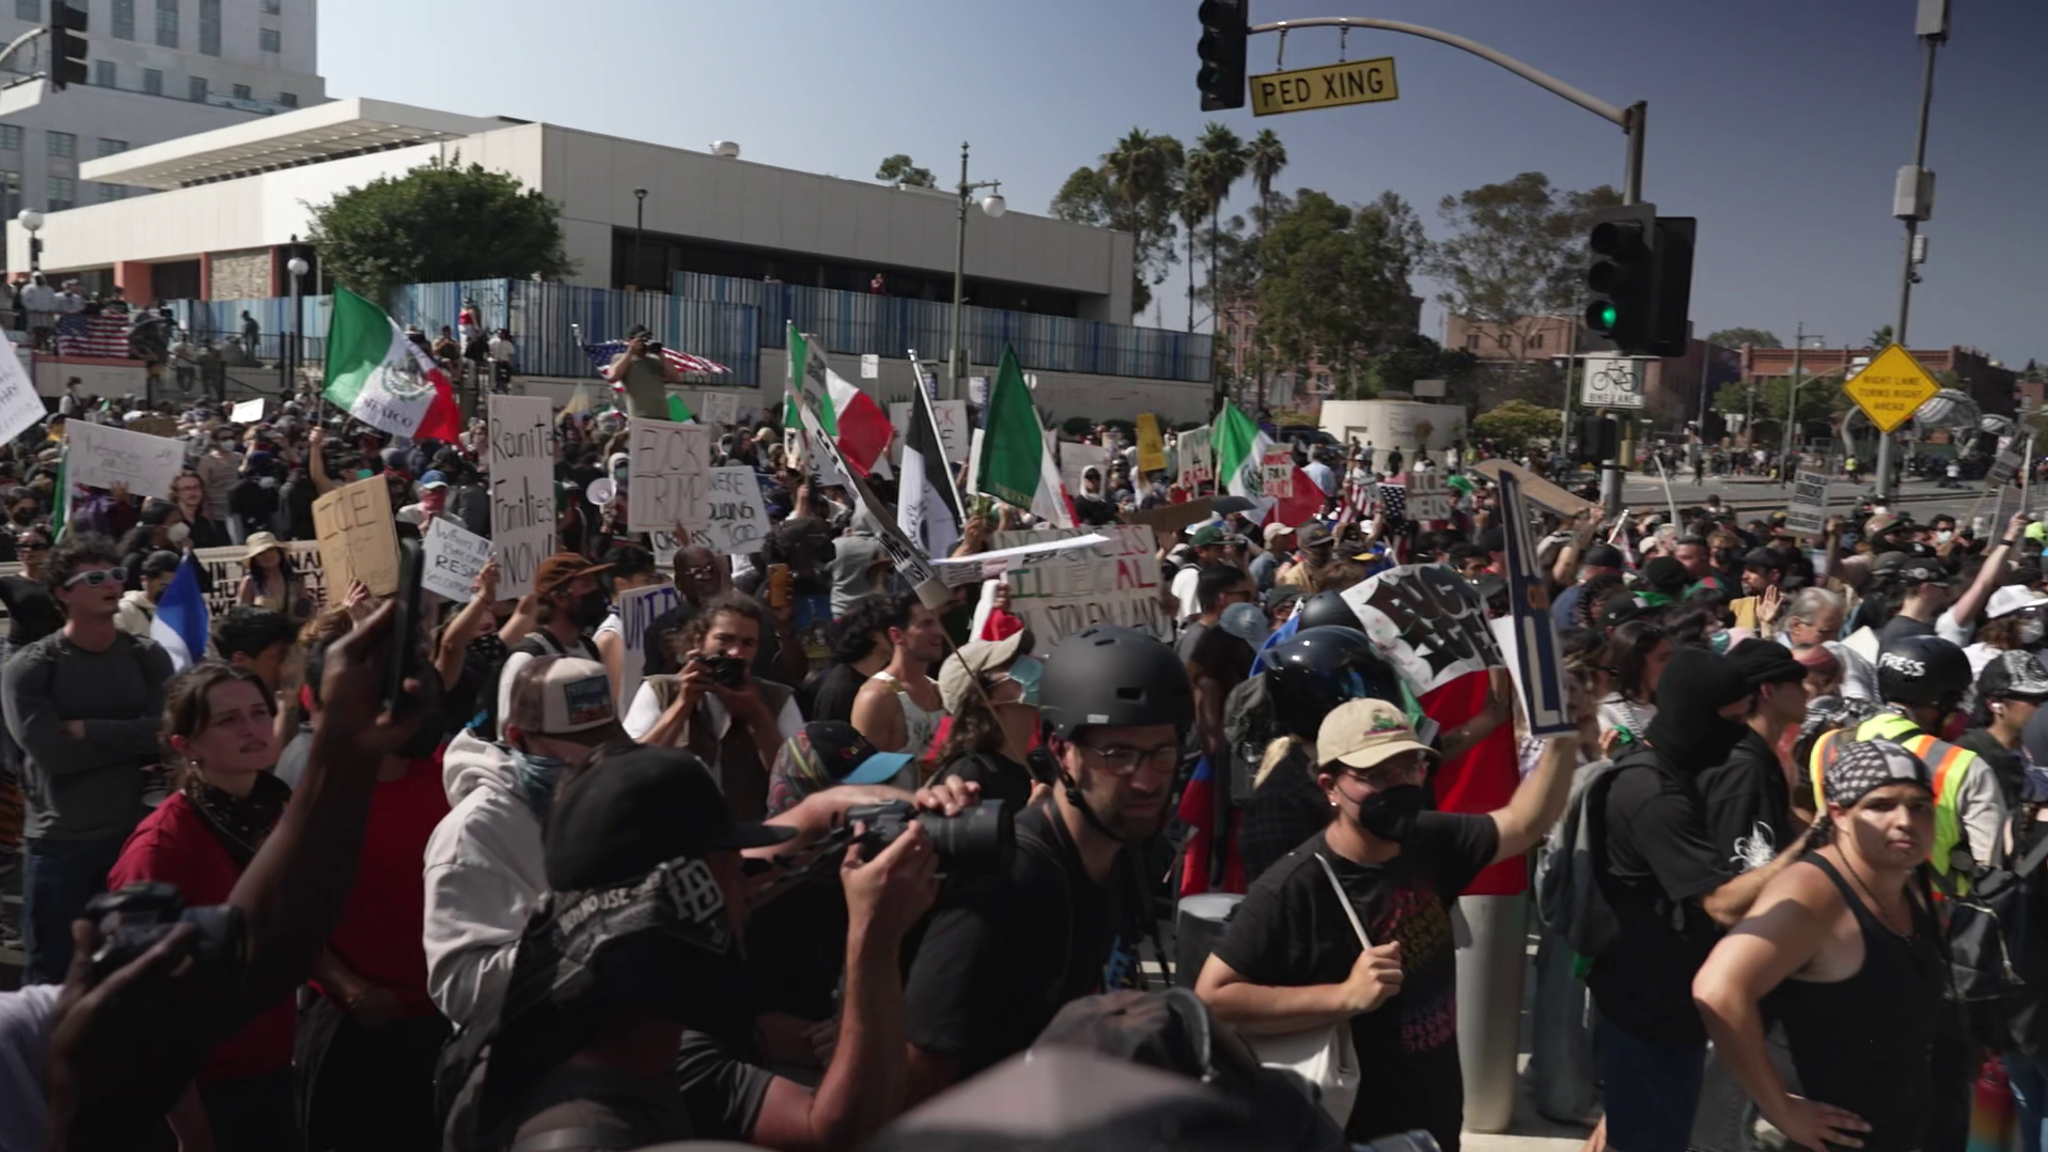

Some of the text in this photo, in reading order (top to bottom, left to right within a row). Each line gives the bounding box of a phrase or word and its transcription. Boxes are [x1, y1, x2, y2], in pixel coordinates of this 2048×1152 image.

[1261, 67, 1384, 107] PED XING
[492, 414, 555, 464] Reunite
[318, 490, 378, 541] ICE
[1115, 524, 1149, 557] IS
[1879, 651, 1926, 677] PRESS
